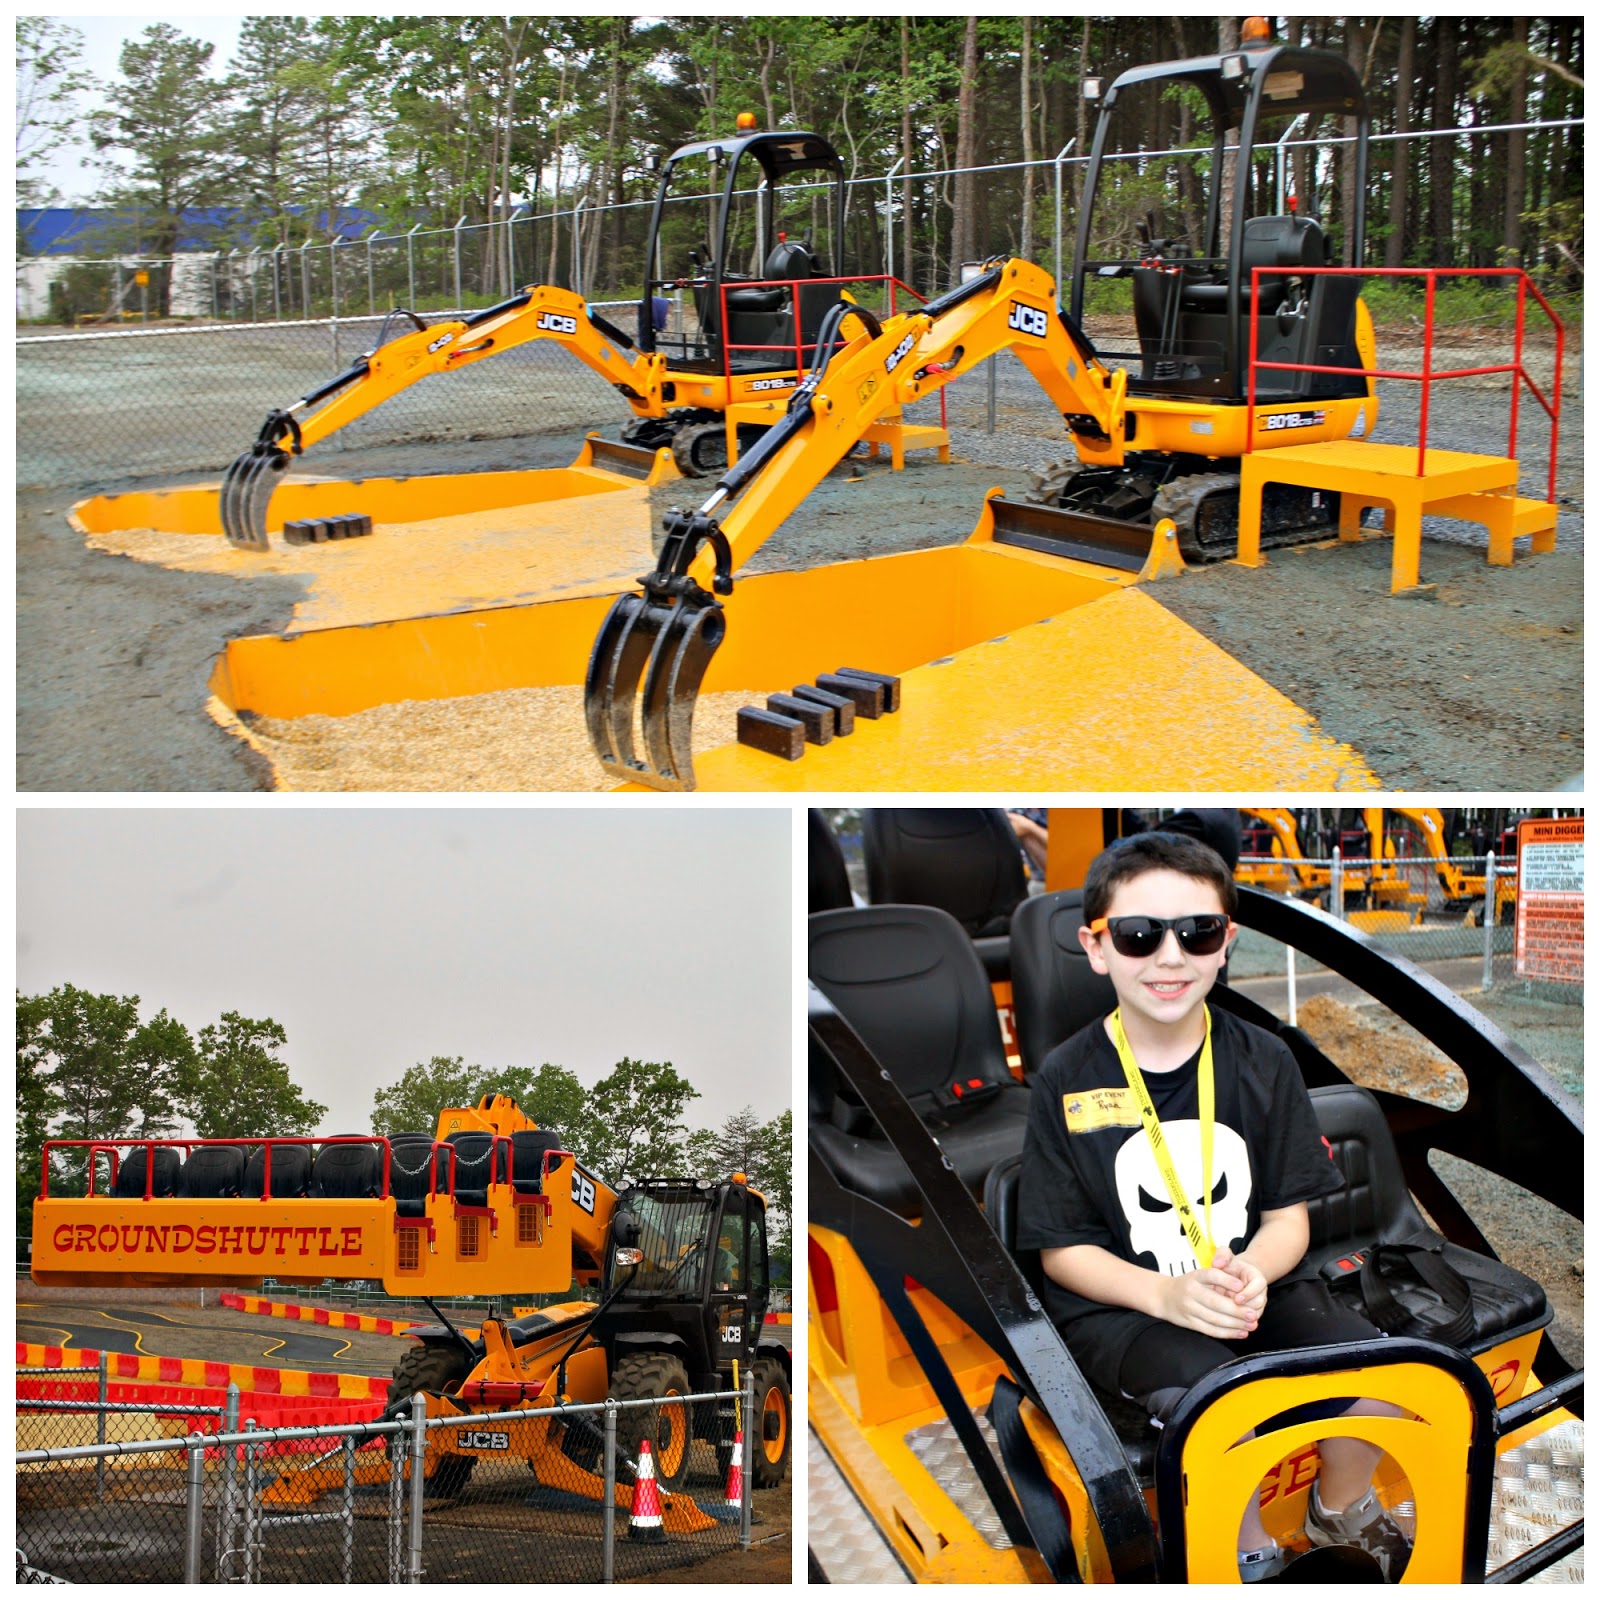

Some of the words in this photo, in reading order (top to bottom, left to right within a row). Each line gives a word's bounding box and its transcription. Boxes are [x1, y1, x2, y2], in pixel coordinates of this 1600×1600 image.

[537, 311, 577, 334] JCB
[1008, 302, 1048, 337] JCB
[1533, 826, 1553, 836] MINI
[1091, 1092, 1103, 1100] VIP
[1096, 1099, 1122, 1112] Ryan
[570, 1168, 596, 1214] CB
[53, 1224, 362, 1256] GROUNDSHUTTLE
[722, 1325, 742, 1343] JCB
[458, 1431, 509, 1449] JCB
